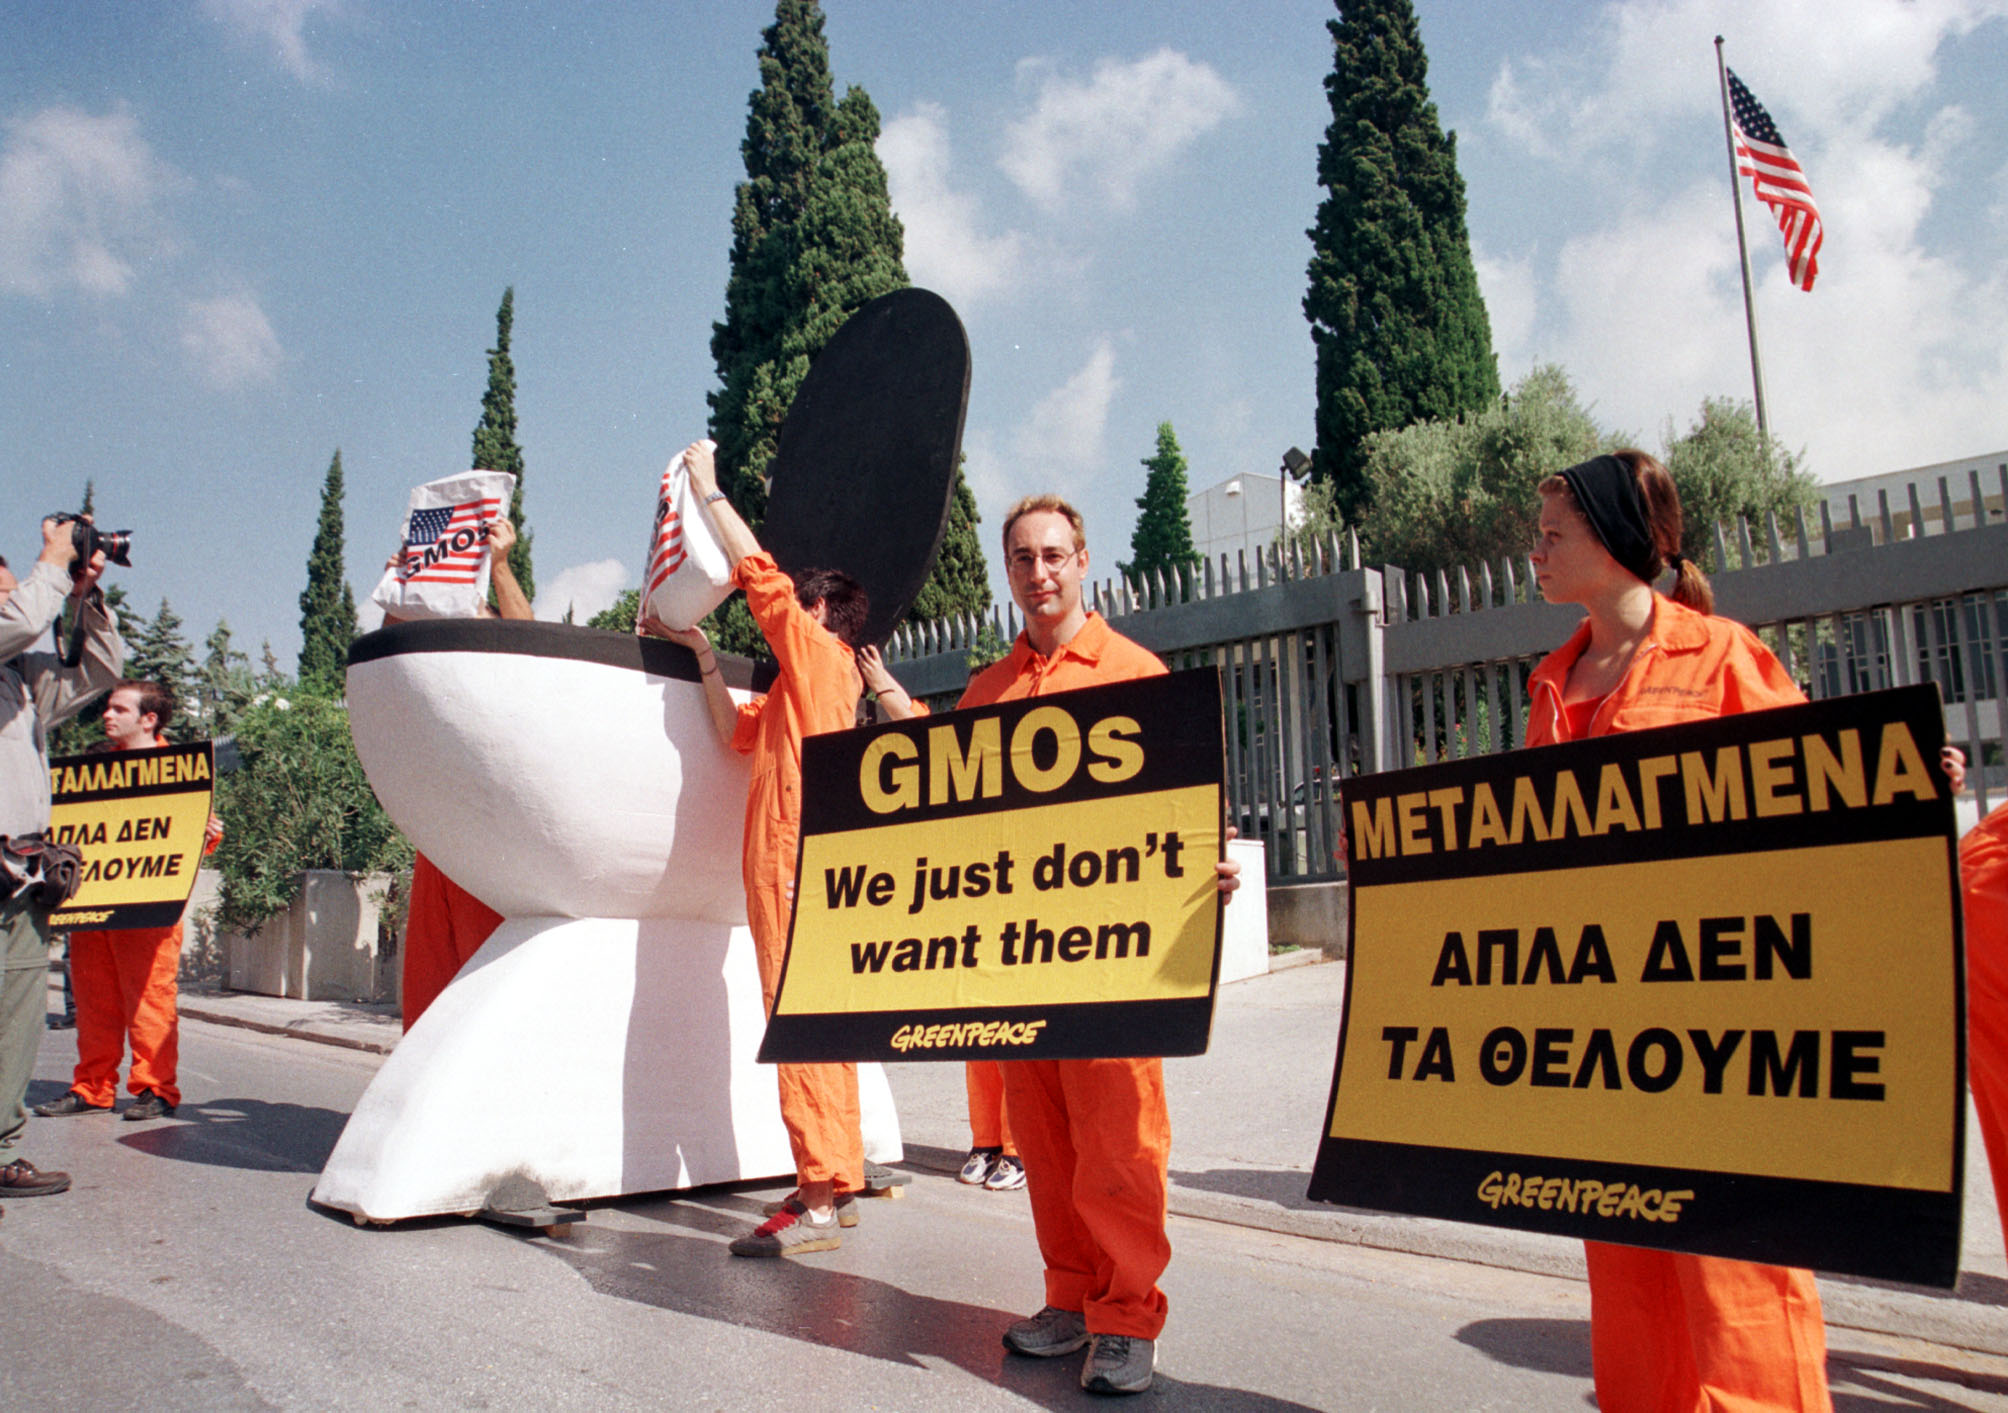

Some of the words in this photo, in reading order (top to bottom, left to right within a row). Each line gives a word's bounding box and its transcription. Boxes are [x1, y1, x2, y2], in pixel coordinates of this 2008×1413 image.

[50, 752, 210, 795] ΤΑΛΛΑΓΜΕΝΑ
[859, 705, 1145, 814] GMOs
[1351, 722, 1939, 861] ΜΕΤΑΛΛΑΓΜΕΝΑ
[116, 816, 171, 842] ΔΕΝ
[81, 854, 183, 882] ΛΟΥΜΕ
[825, 866, 895, 909] We
[909, 851, 1014, 914] just
[1034, 832, 1184, 890] don’t
[851, 926, 981, 974] want
[1001, 919, 1151, 966] them
[1431, 924, 1617, 986] ΑΠΛΑ
[1641, 913, 1812, 983] ΔΕΝ
[890, 1019, 1047, 1053] GREENPEACE
[1381, 1026, 1456, 1083] ΤΑ
[1480, 1026, 1886, 1102] ΘΕΛΟΥΜΕ
[1477, 1171, 1695, 1223] GREENPEACE
